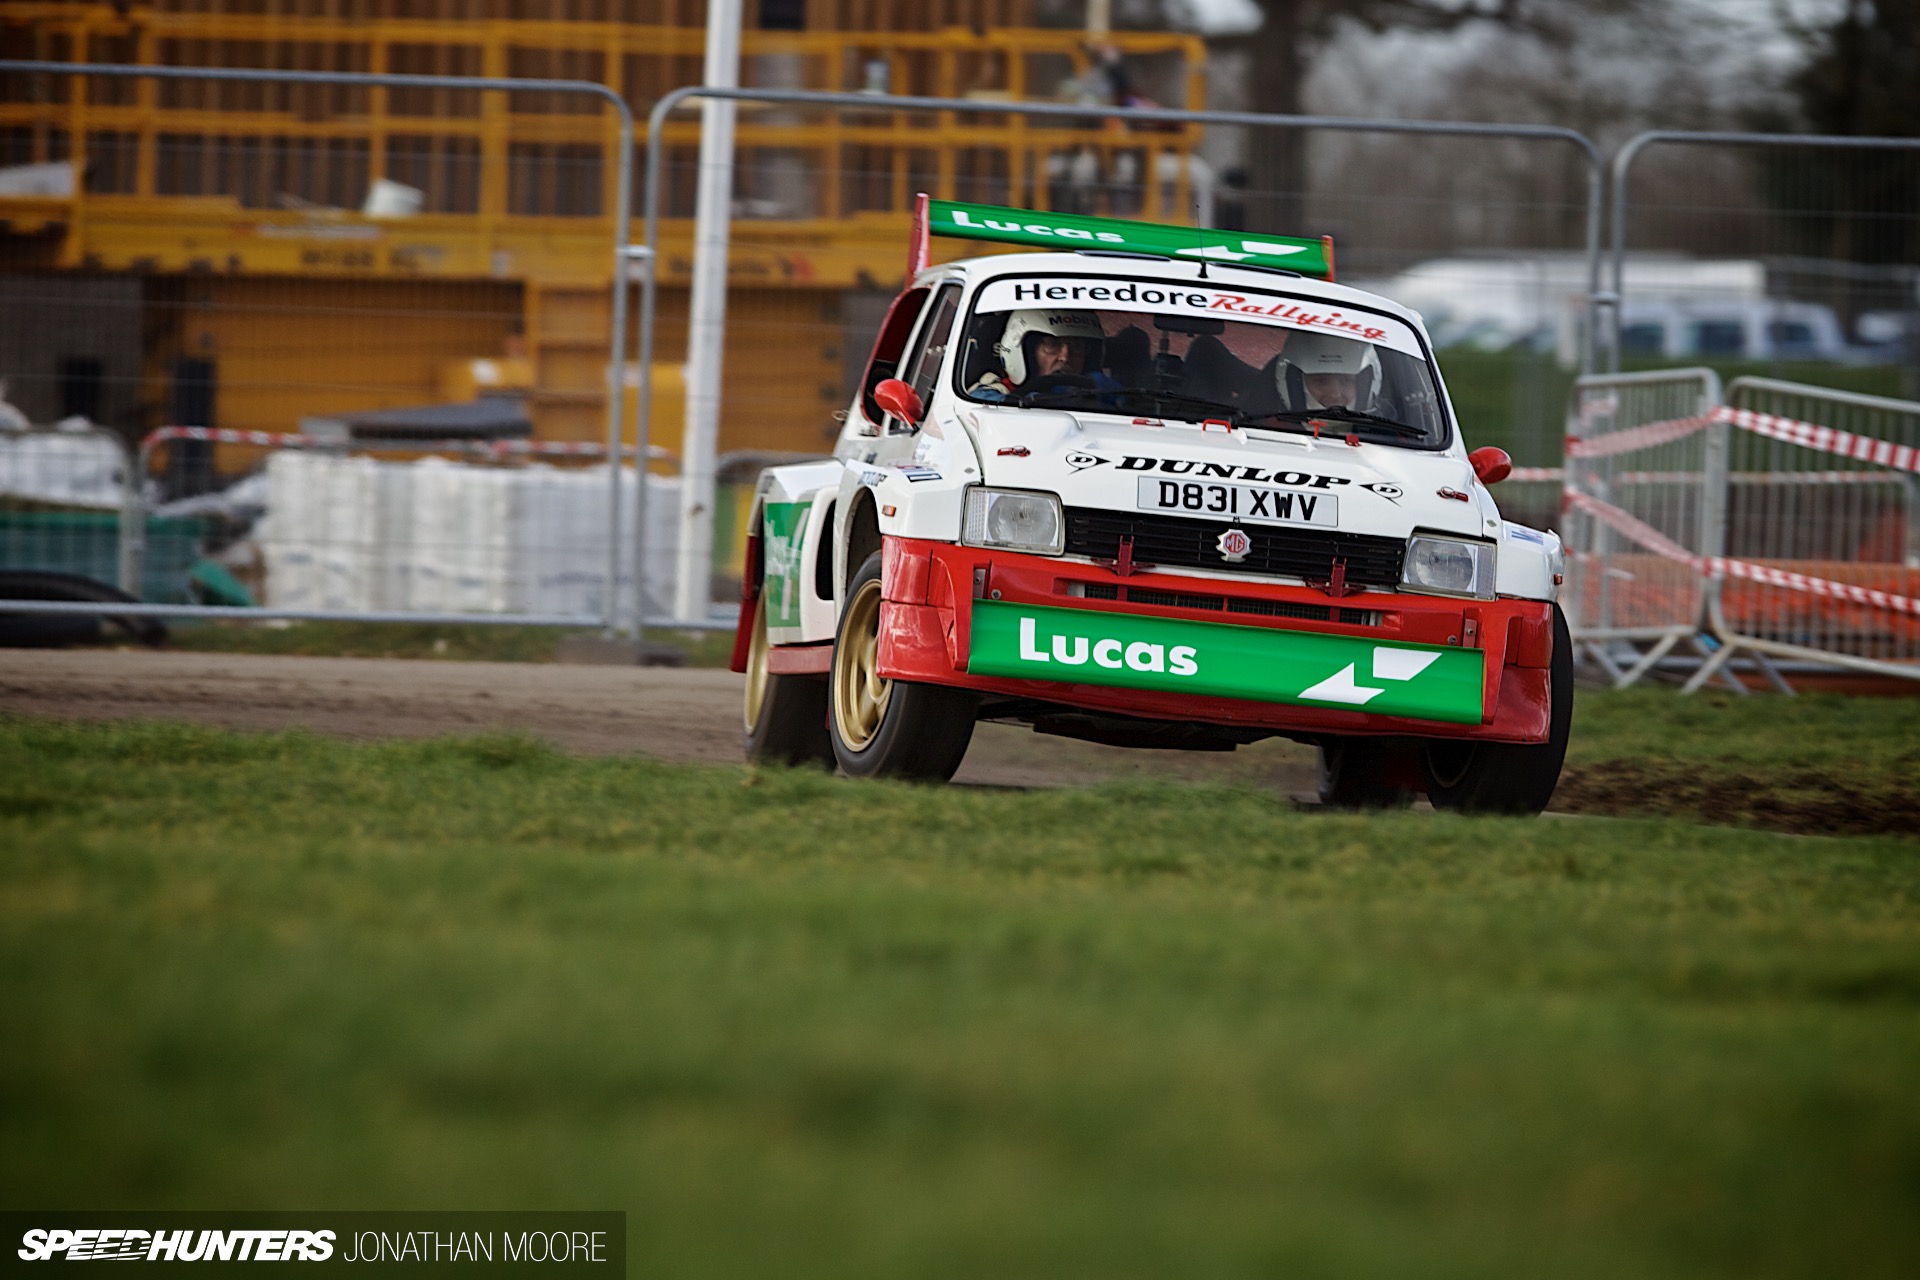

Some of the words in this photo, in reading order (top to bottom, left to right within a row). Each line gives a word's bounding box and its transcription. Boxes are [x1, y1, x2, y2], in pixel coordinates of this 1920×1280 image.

[951, 210, 1125, 243] Lucas
[1114, 456, 1352, 489] DUNLOP
[1158, 480, 1237, 514] D831
[1249, 489, 1317, 521] XWV
[1225, 534, 1245, 549] MG
[1019, 617, 1198, 676] Lucas
